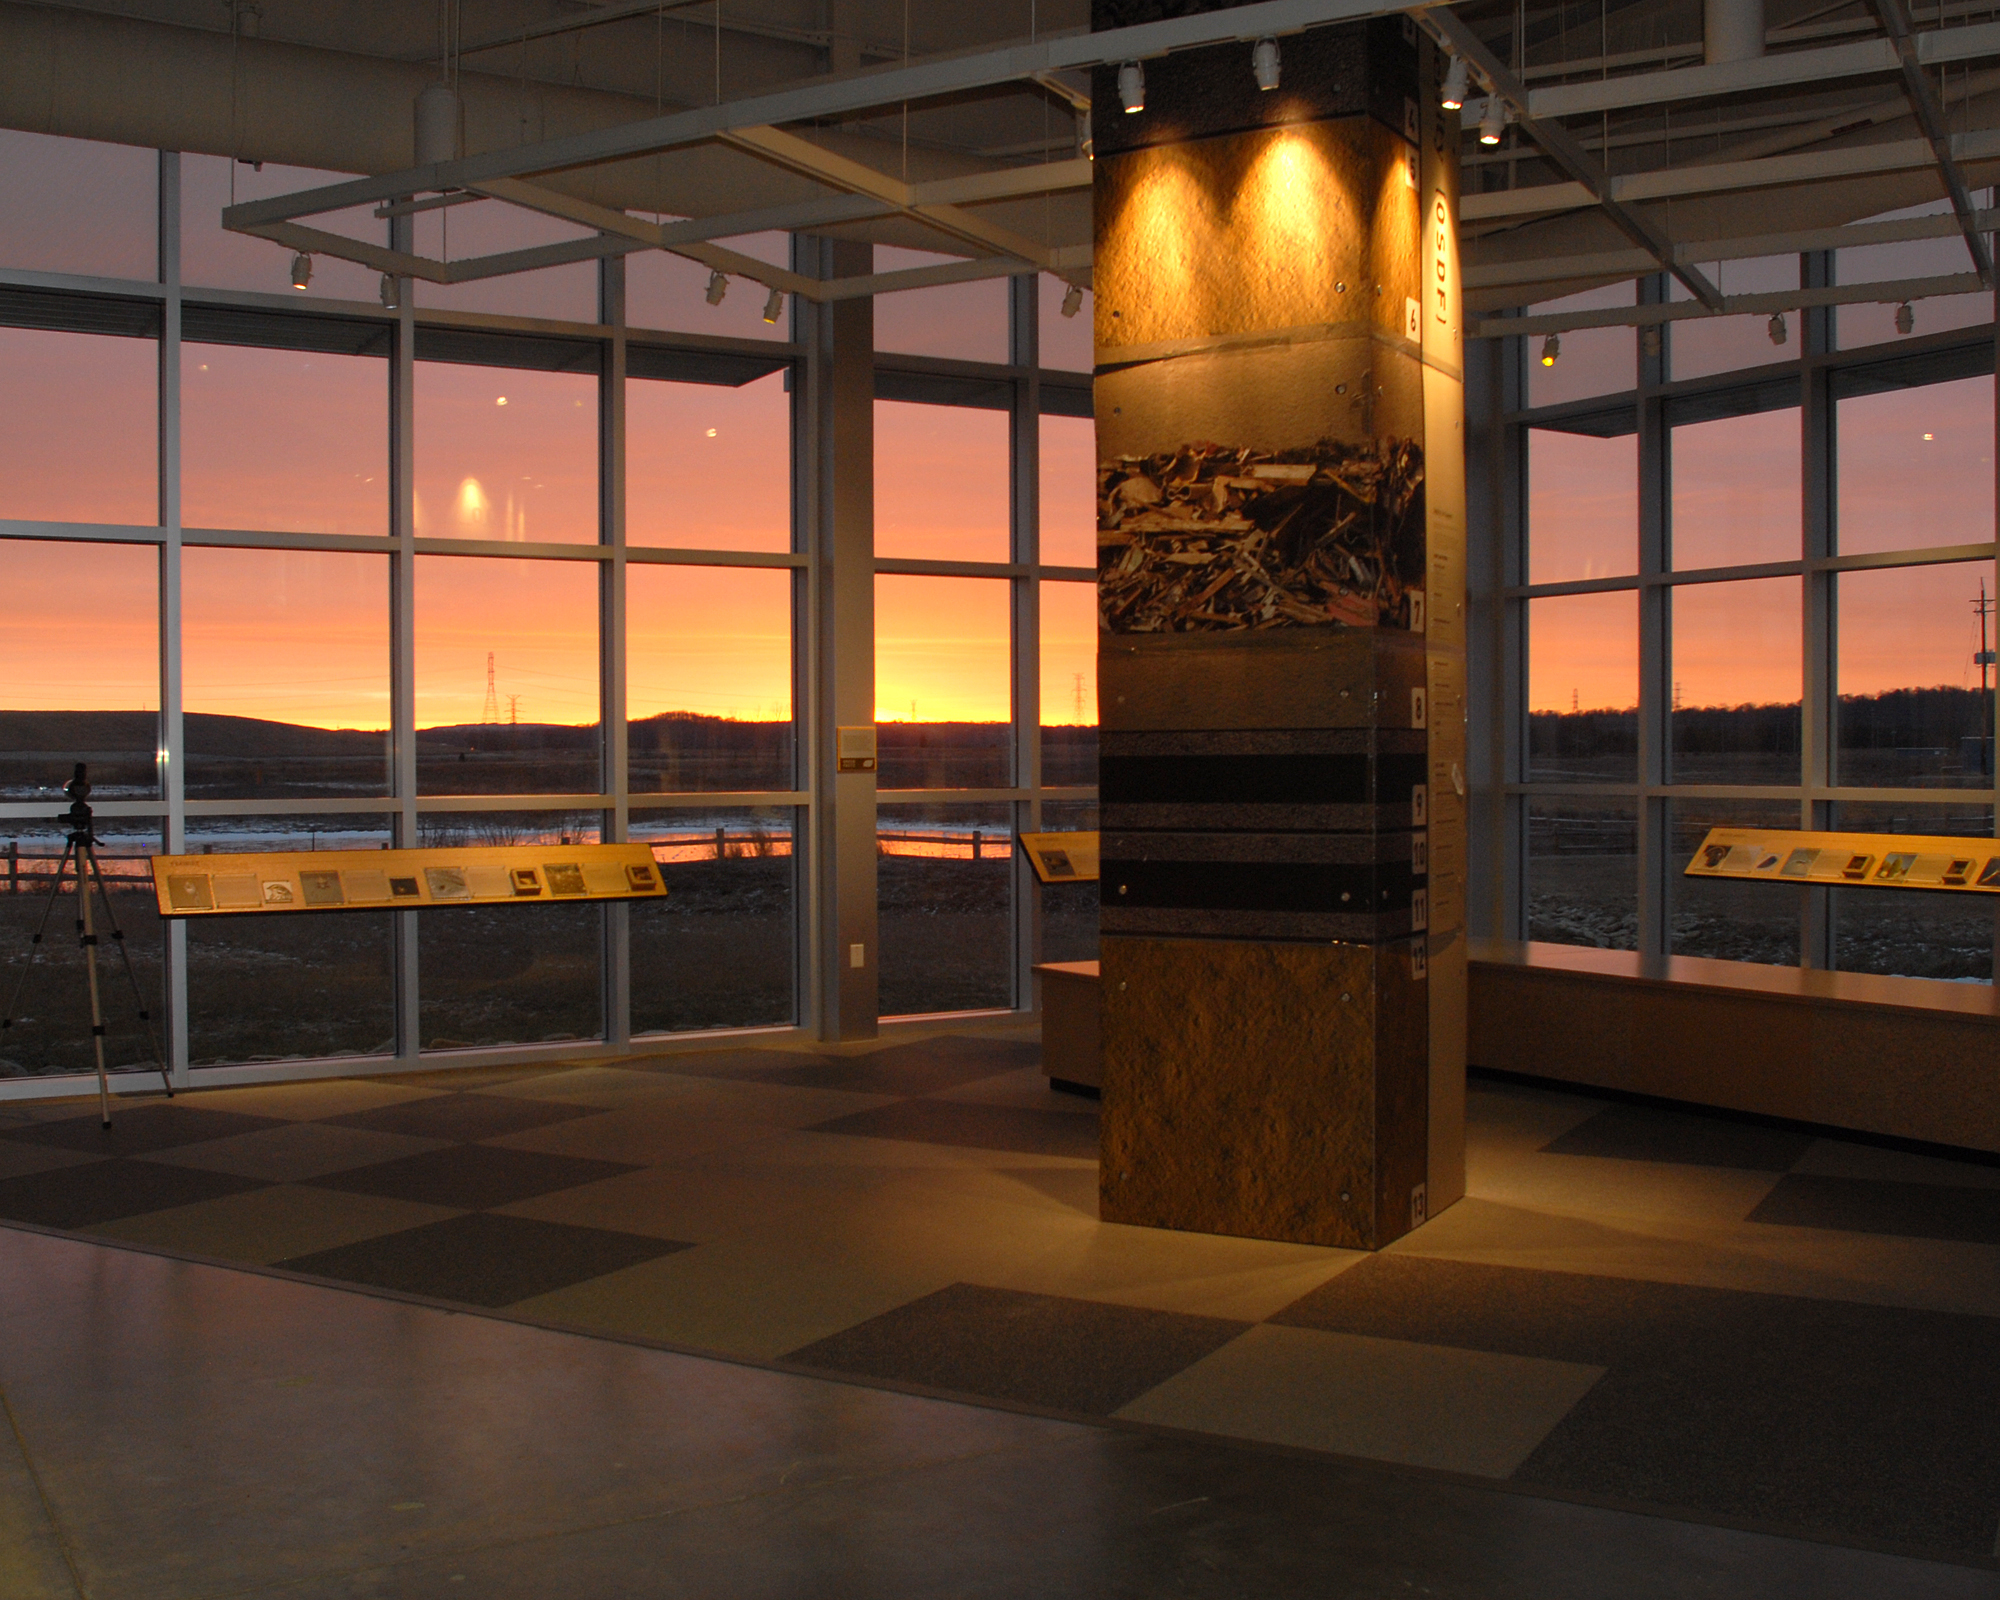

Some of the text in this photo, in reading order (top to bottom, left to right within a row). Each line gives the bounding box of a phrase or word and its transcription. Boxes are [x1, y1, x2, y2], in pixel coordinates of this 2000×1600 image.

[1410, 157, 1416, 181] 5
[1435, 188, 1447, 324] (OSDF)
[1411, 309, 1417, 332] 6
[1414, 600, 1420, 624] 7
[1416, 696, 1422, 720] 8
[1416, 793, 1422, 817] 9
[1414, 842, 1424, 867] 10
[1415, 898, 1424, 922] 11
[1414, 946, 1424, 971] 12
[1413, 1193, 1423, 1219] 13
